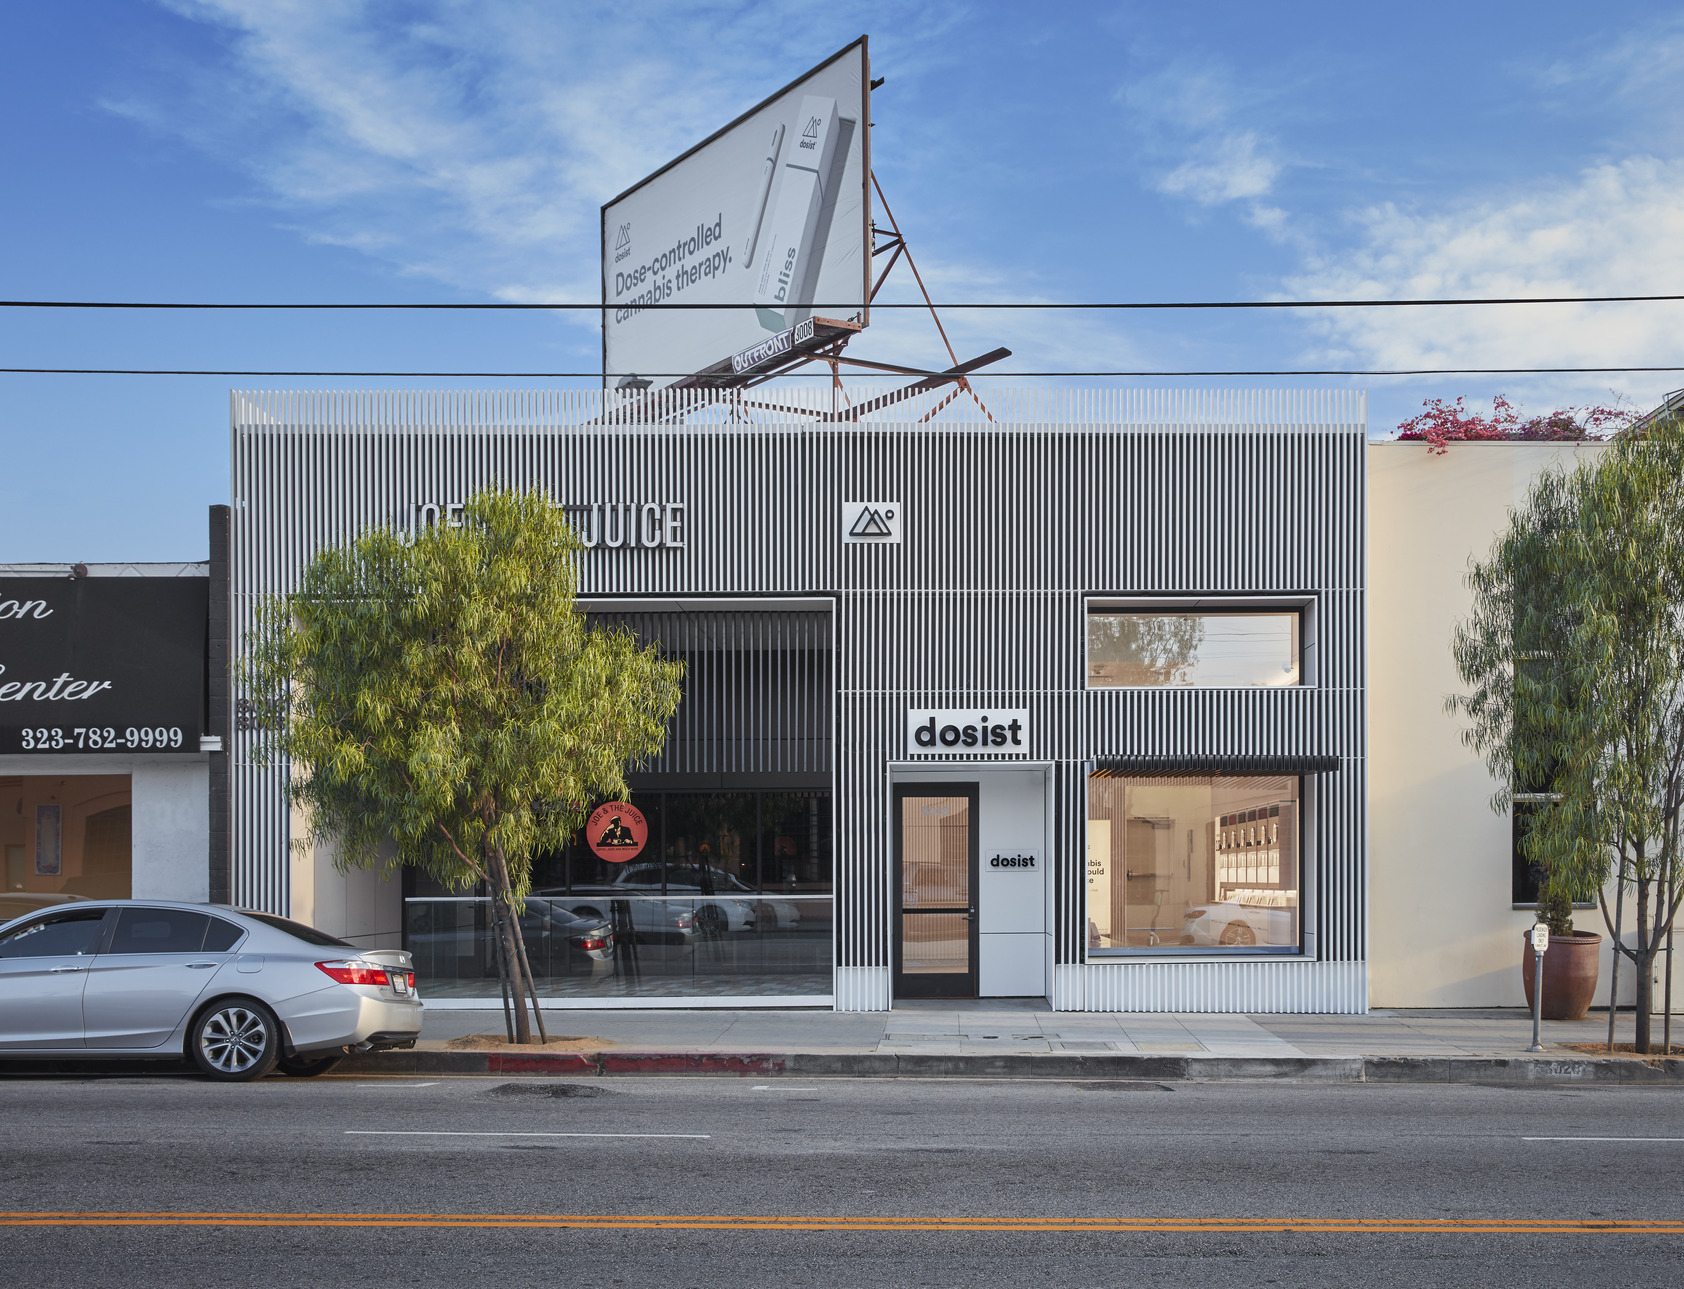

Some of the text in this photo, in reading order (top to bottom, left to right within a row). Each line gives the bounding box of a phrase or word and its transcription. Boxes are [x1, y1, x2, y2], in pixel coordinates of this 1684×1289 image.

[799, 139, 817, 150] dosist
[615, 246, 631, 263] dosist
[615, 213, 722, 297] Dose-controlled
[615, 274, 672, 324] cannabis
[676, 246, 733, 291] therapy.
[774, 247, 796, 302] bliss
[734, 320, 813, 371] OUTFRONT 3008
[399, 503, 465, 548] JOE
[582, 502, 684, 548] JUICE
[0, 593, 54, 619] on
[21, 727, 183, 749] 323-782-9999
[914, 715, 1022, 747] dosist
[591, 804, 643, 826] JOE & THE JUICE
[921, 805, 949, 816] 8018
[990, 854, 1035, 867] dosist
